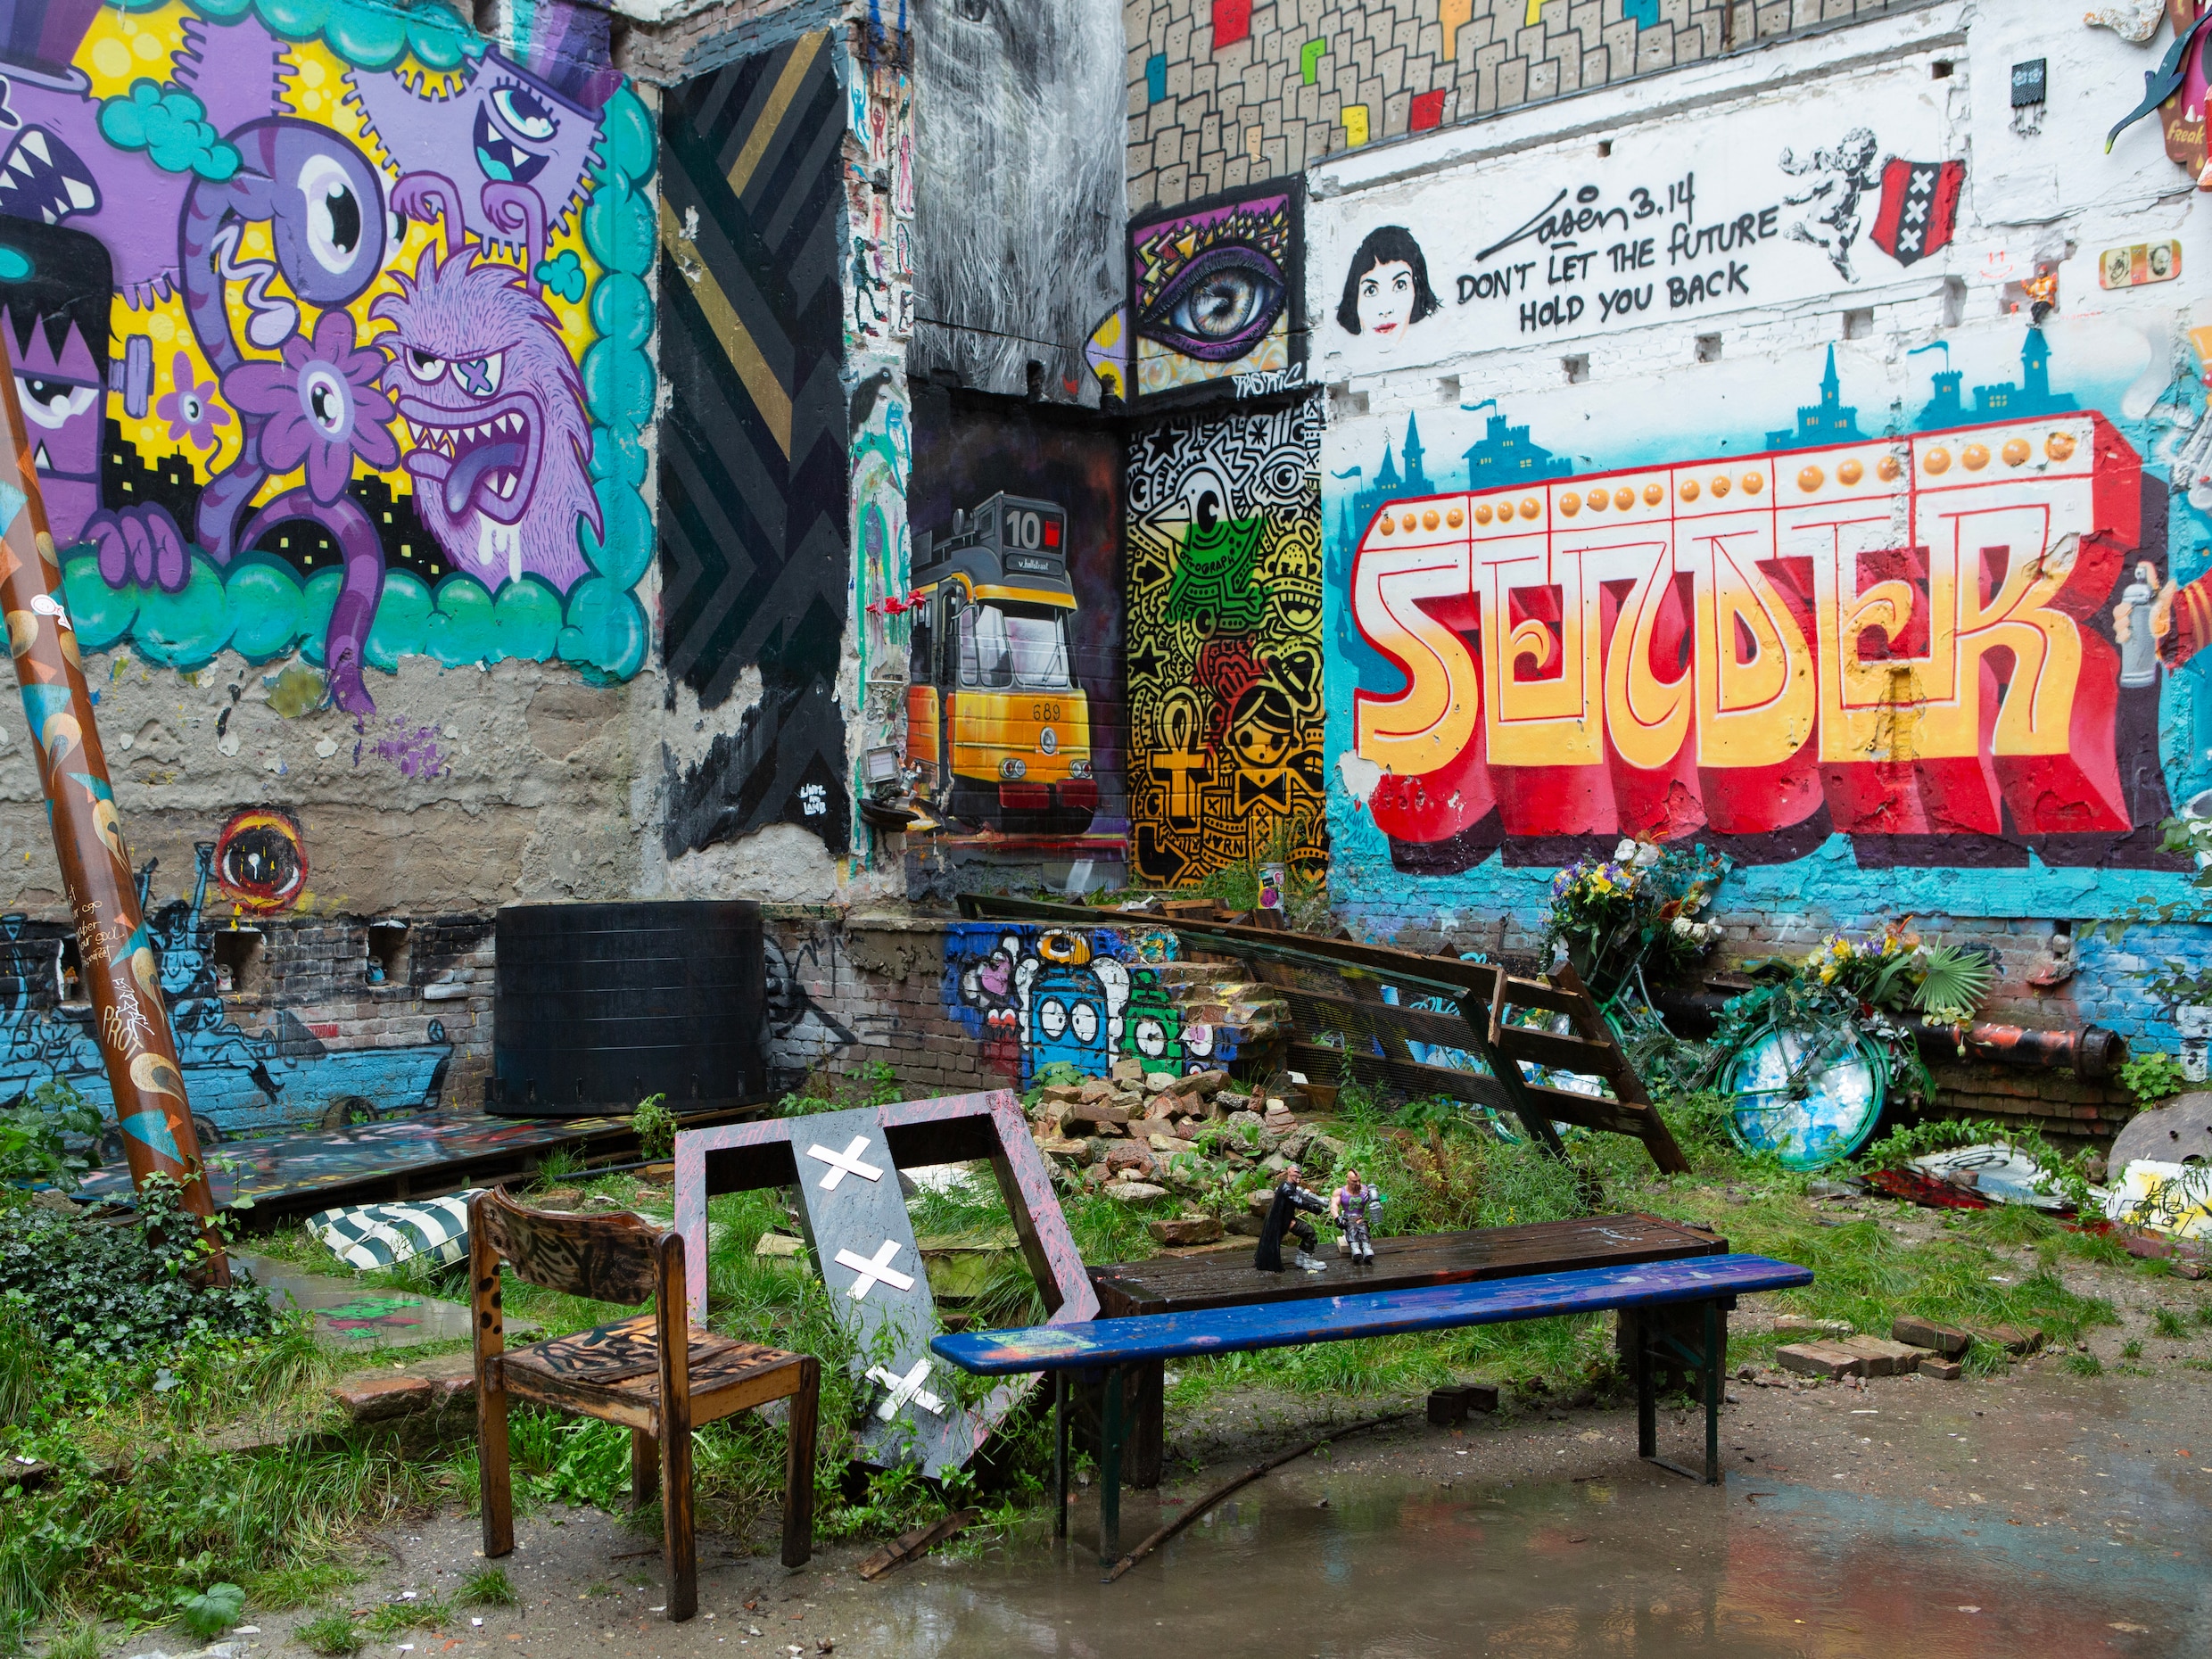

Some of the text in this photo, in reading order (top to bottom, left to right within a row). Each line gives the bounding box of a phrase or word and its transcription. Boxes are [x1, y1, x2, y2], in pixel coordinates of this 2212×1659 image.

[1630, 171, 1695, 225] 3.14
[1548, 246, 1598, 285] LET
[1606, 237, 1655, 273] THE
[1519, 260, 1749, 333] HOLD YOU BACK
[1006, 510, 1041, 550] 10
[1033, 702, 1061, 721] 689
